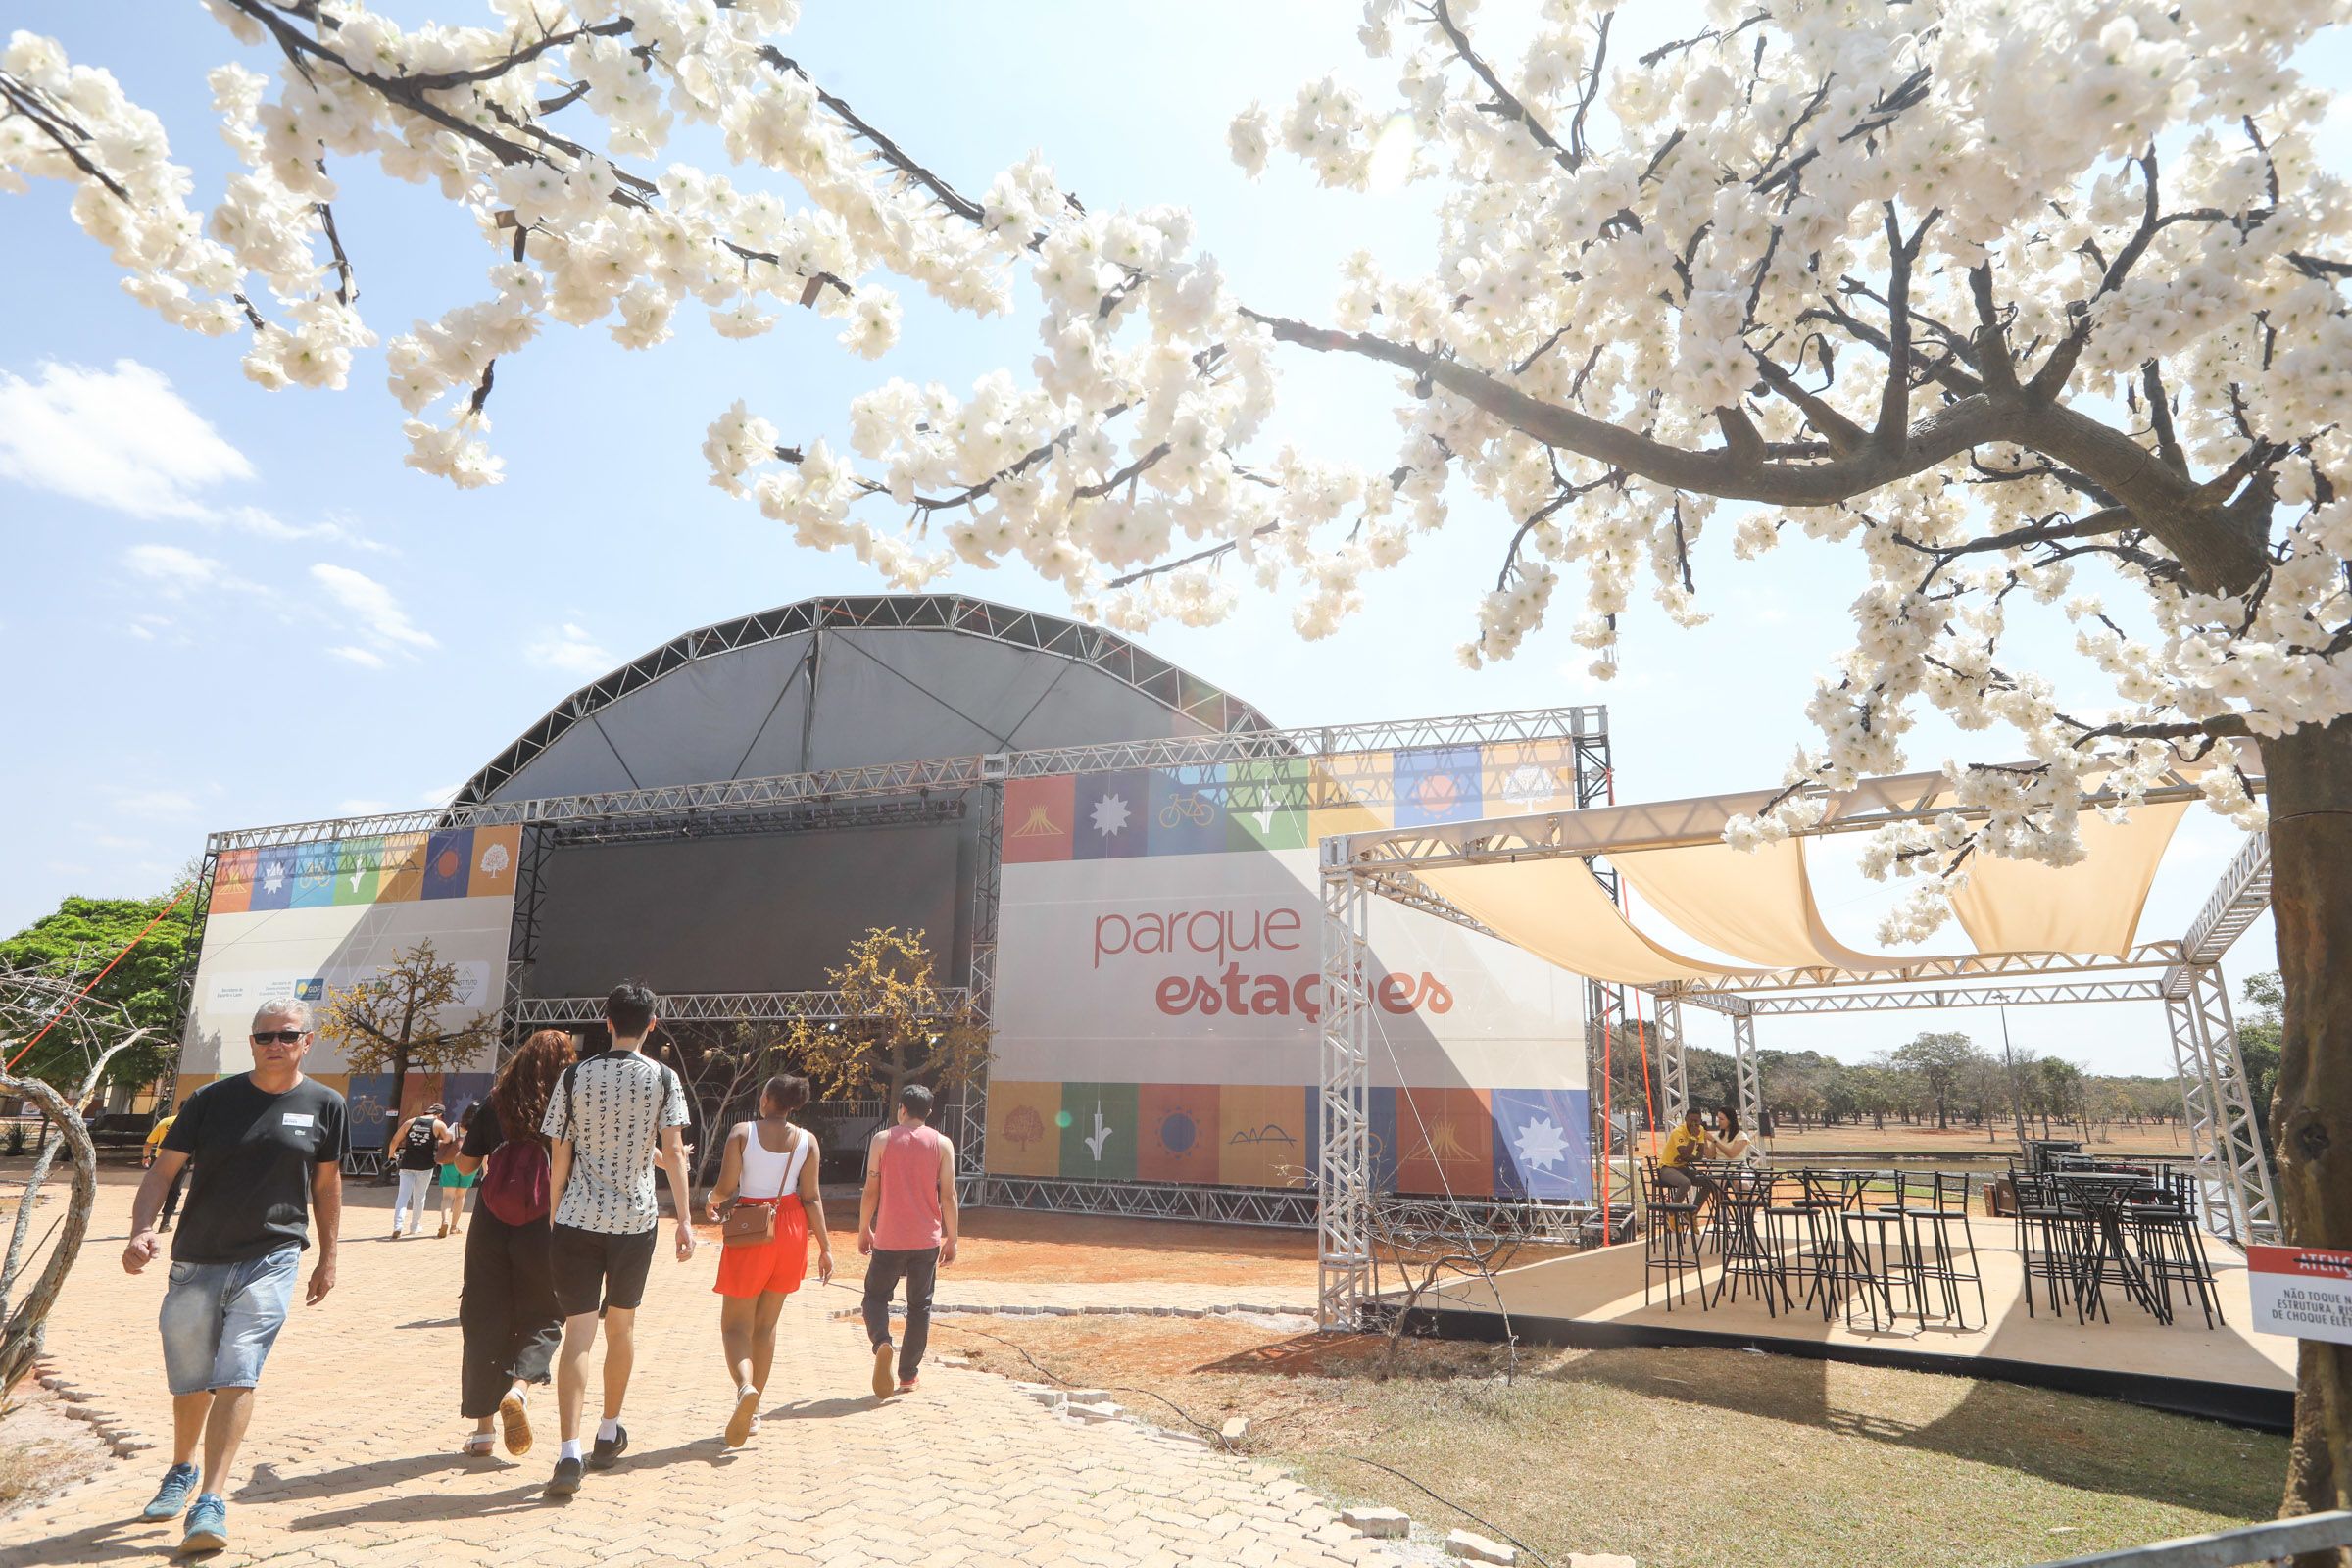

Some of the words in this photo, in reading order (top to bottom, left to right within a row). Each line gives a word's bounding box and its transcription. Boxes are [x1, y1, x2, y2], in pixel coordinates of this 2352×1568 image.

[1094, 907, 1301, 969] parque
[2283, 1287, 2305, 1300] NÃO
[2308, 1291, 2341, 1304] TOQUE
[2272, 1308, 2283, 1320] DE
[2286, 1310, 2328, 1325] CHOQUE
